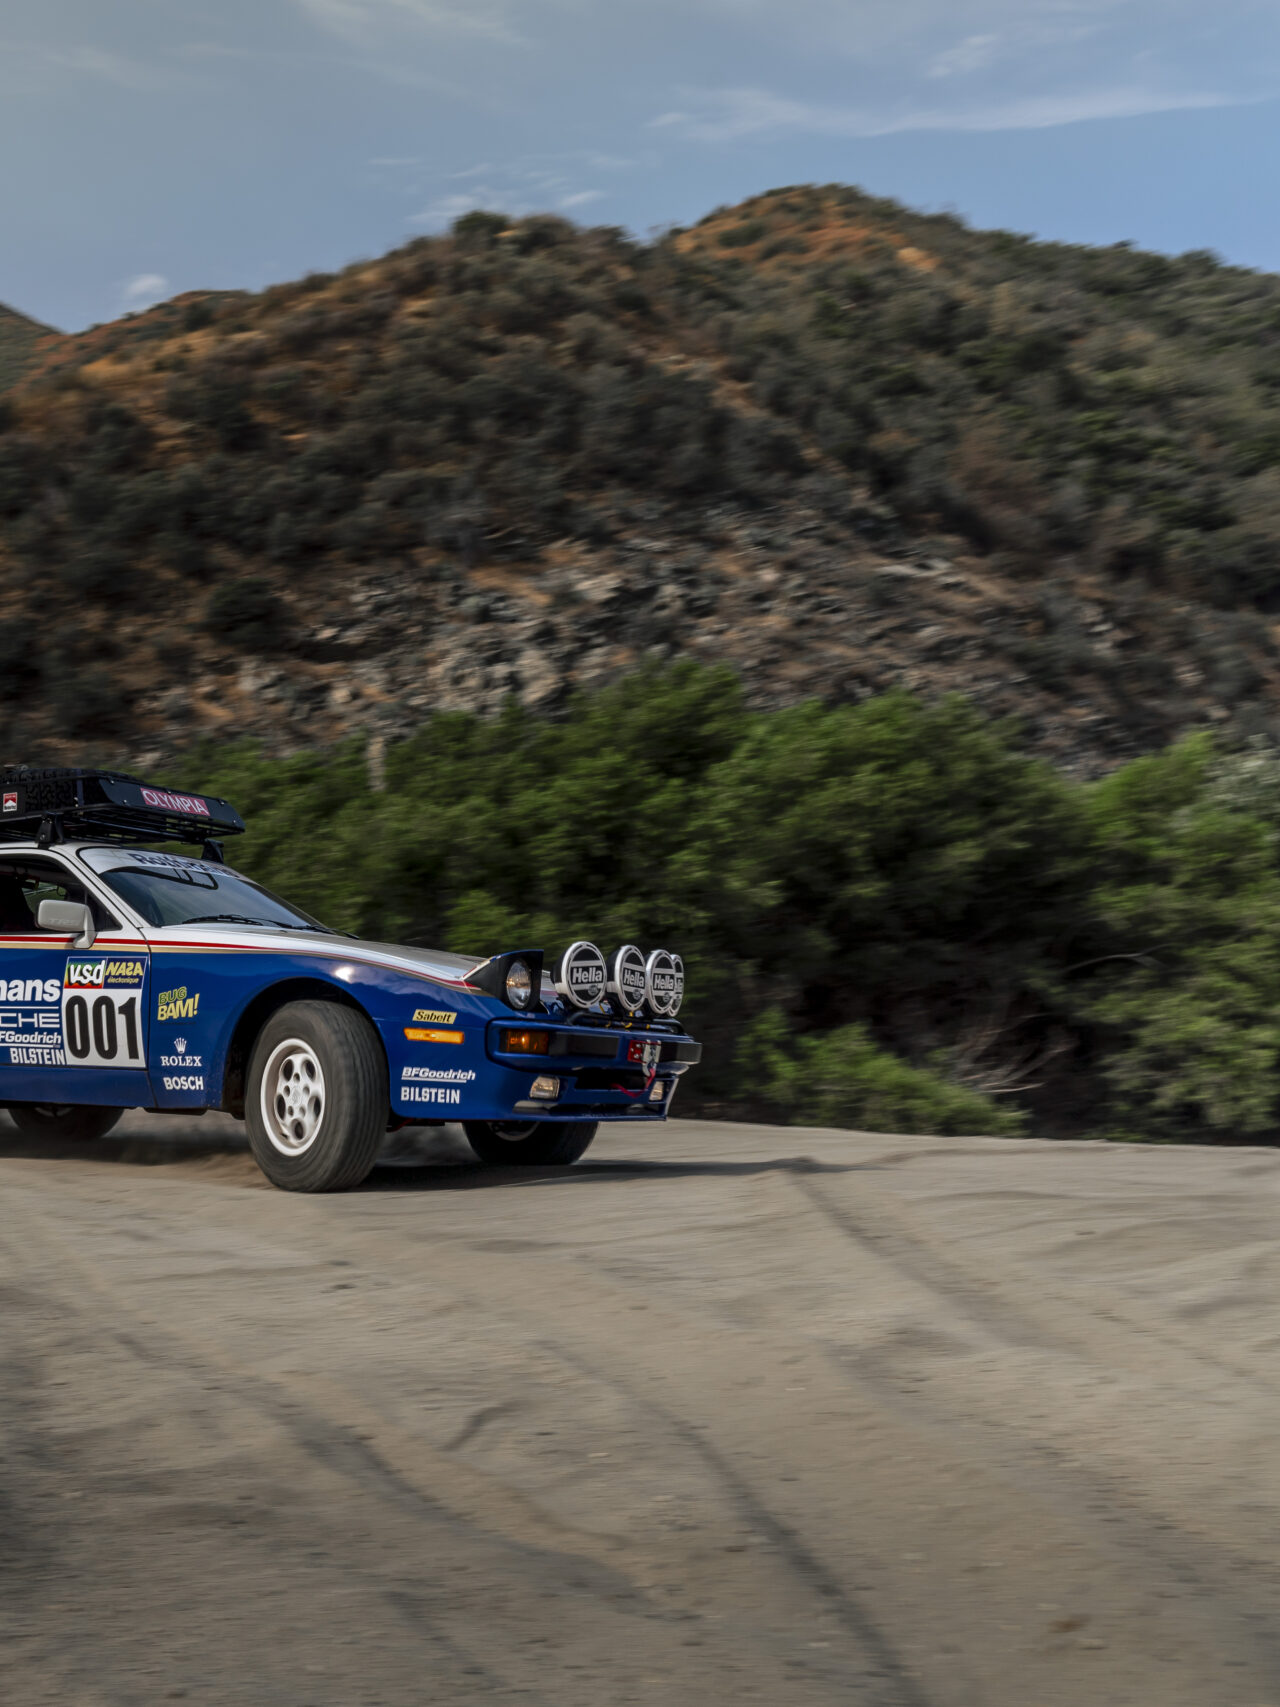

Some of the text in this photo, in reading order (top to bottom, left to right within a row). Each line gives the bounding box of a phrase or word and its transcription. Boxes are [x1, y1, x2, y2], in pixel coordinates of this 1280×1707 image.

[142, 790, 209, 815] OLYMPIA
[572, 965, 603, 983] Hella
[623, 968, 645, 988] Hella
[654, 974, 674, 990] Hella
[158, 986, 187, 1006] BUG
[157, 993, 200, 1021] BAM!
[416, 1011, 452, 1023] Sabelt
[65, 995, 139, 1060] 001
[10, 1048, 65, 1065] BILSTEIN
[160, 1056, 202, 1067] ROLEX
[402, 1066, 476, 1081] BFGoodrich
[163, 1076, 204, 1091] BOSCH
[401, 1086, 461, 1105] BILSTEIN
